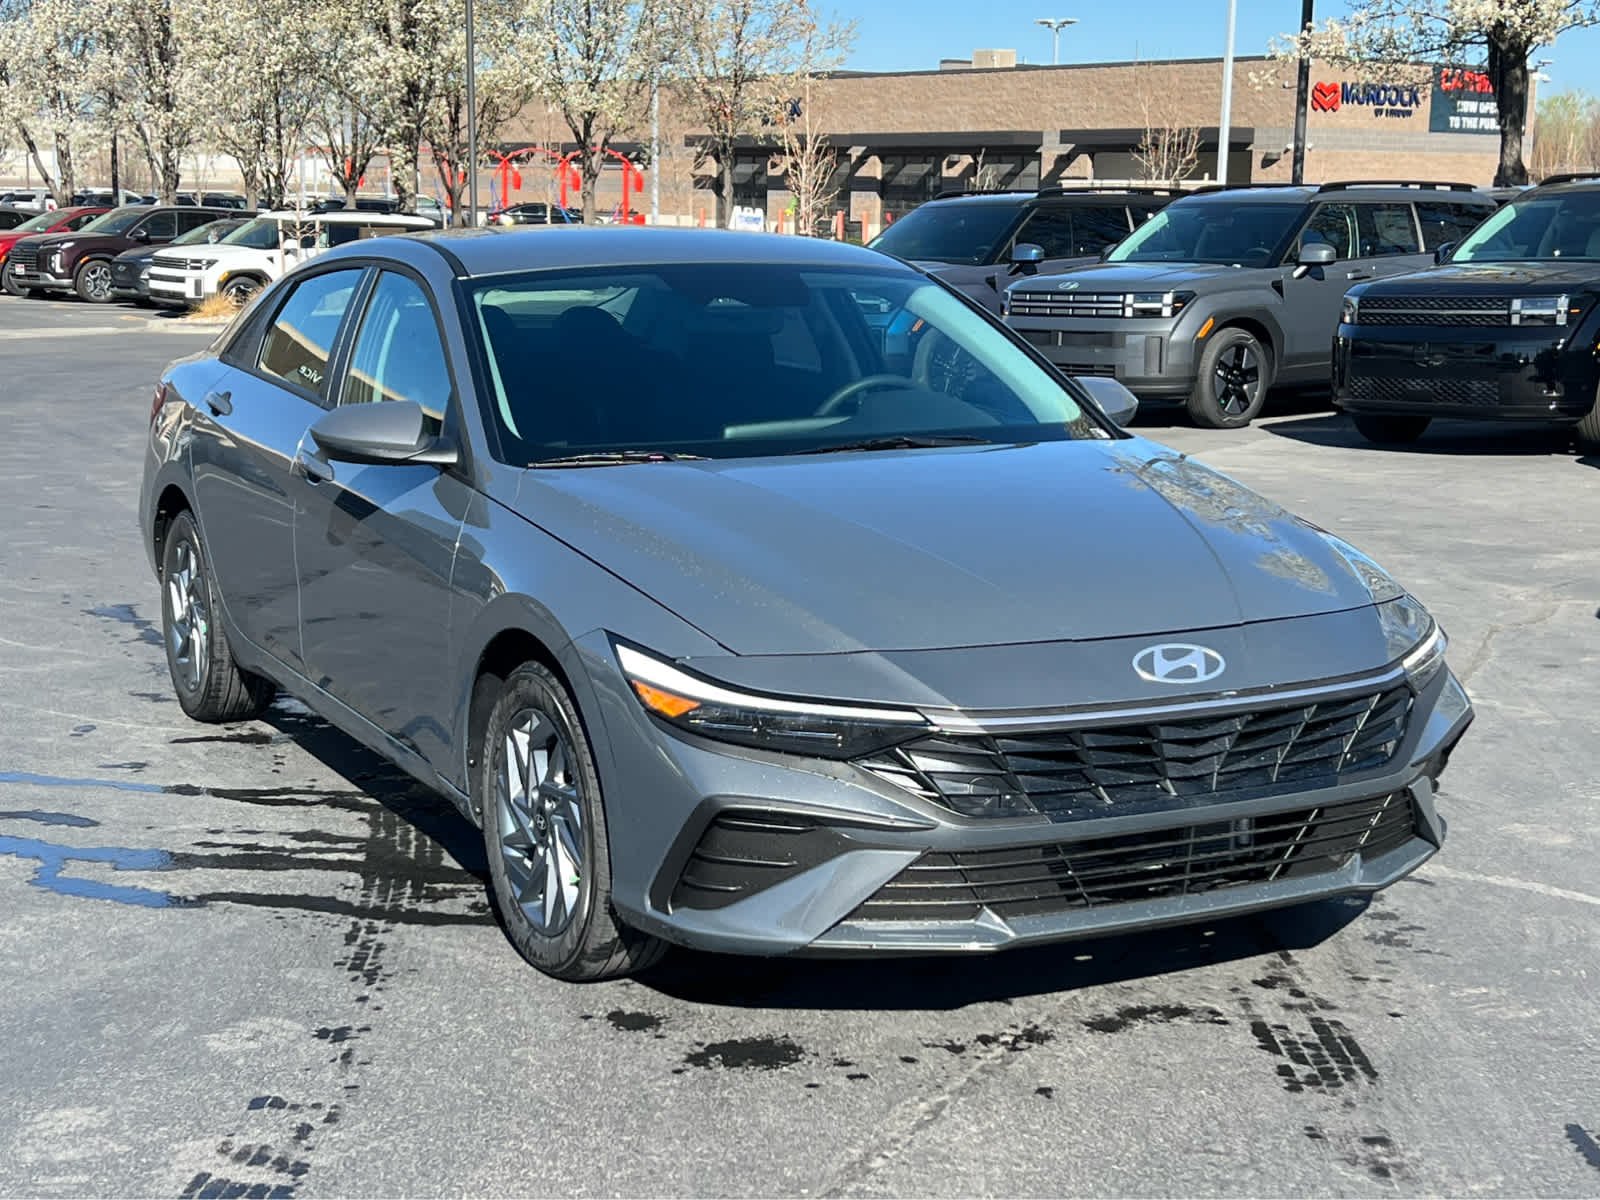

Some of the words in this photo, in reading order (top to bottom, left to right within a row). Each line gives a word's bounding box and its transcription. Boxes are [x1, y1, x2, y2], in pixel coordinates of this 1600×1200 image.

[1341, 82, 1421, 108] MURDOCK
[1449, 116, 1460, 129] TO
[1461, 116, 1478, 129] THE
